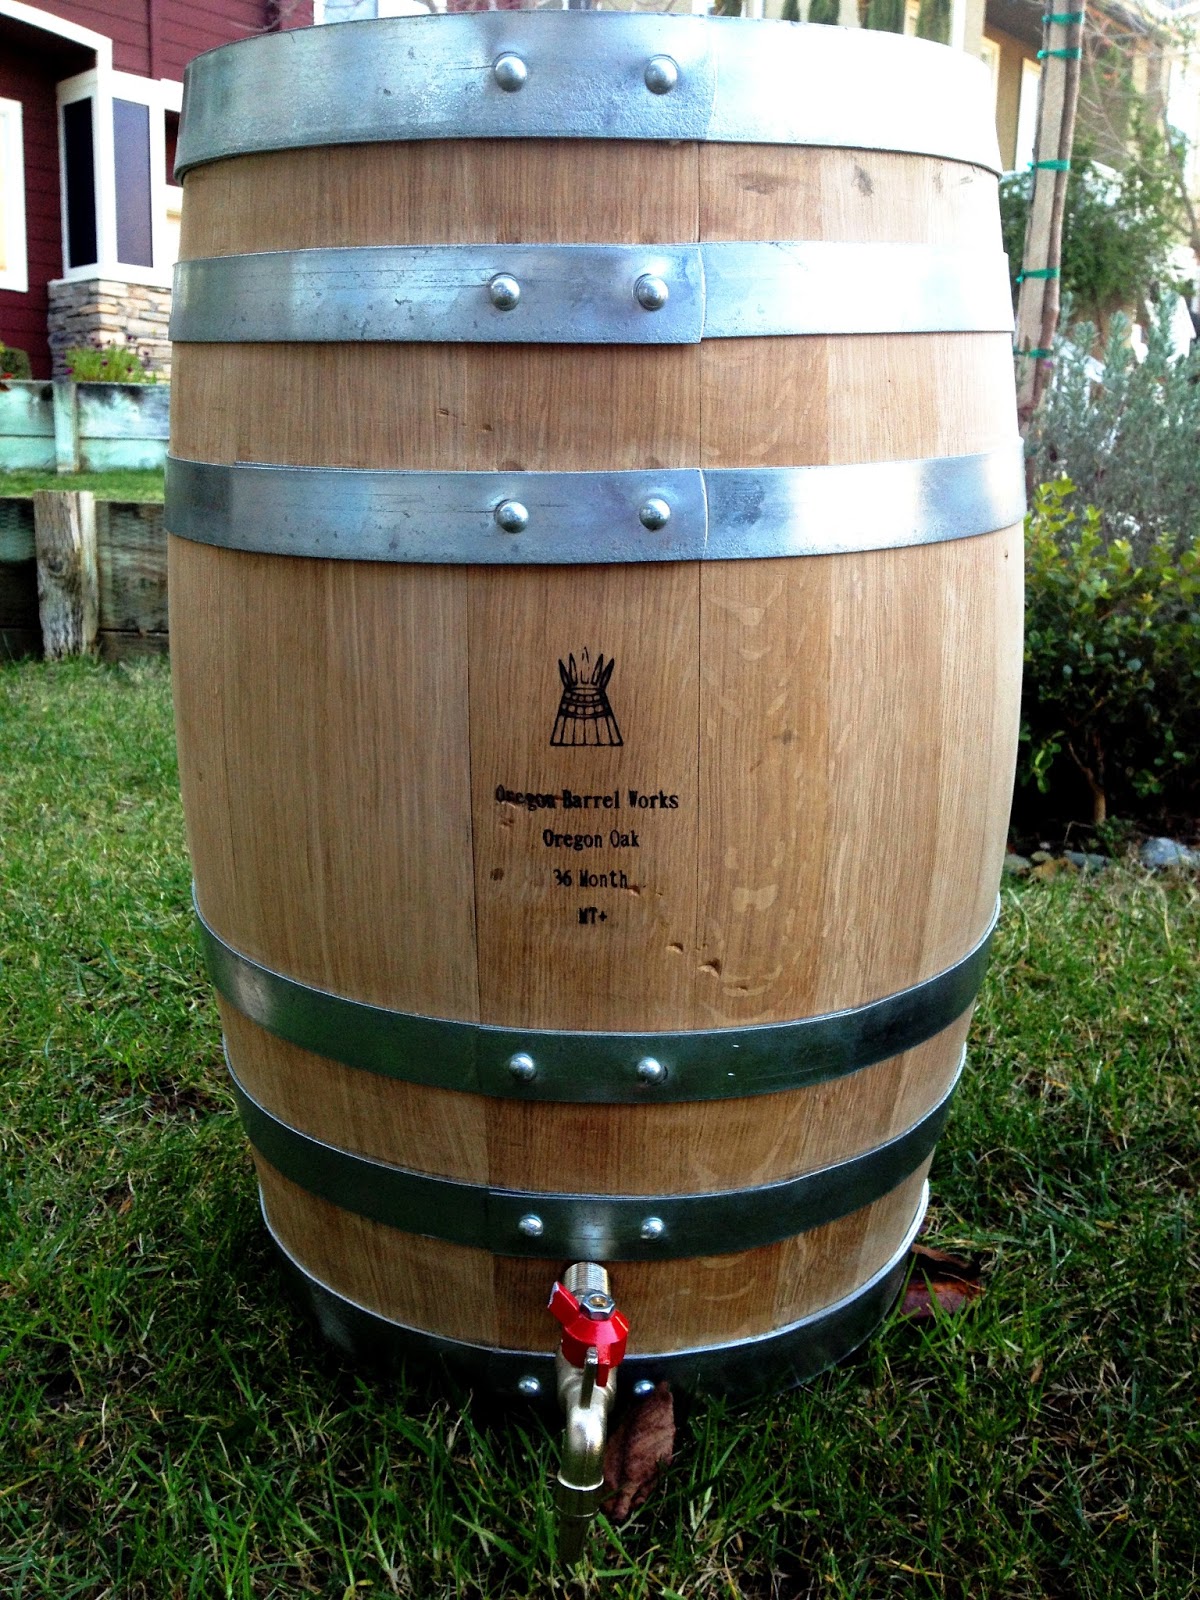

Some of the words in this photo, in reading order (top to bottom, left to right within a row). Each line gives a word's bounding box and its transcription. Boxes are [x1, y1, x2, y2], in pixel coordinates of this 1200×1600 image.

[495, 784, 556, 811] Oregon
[562, 789, 620, 809] Barrel
[628, 790, 679, 809] Works
[542, 829, 603, 851] Oregon
[609, 829, 640, 848] Oak
[553, 869, 572, 887] 36
[579, 869, 628, 888] Month
[578, 906, 608, 924] MT+
